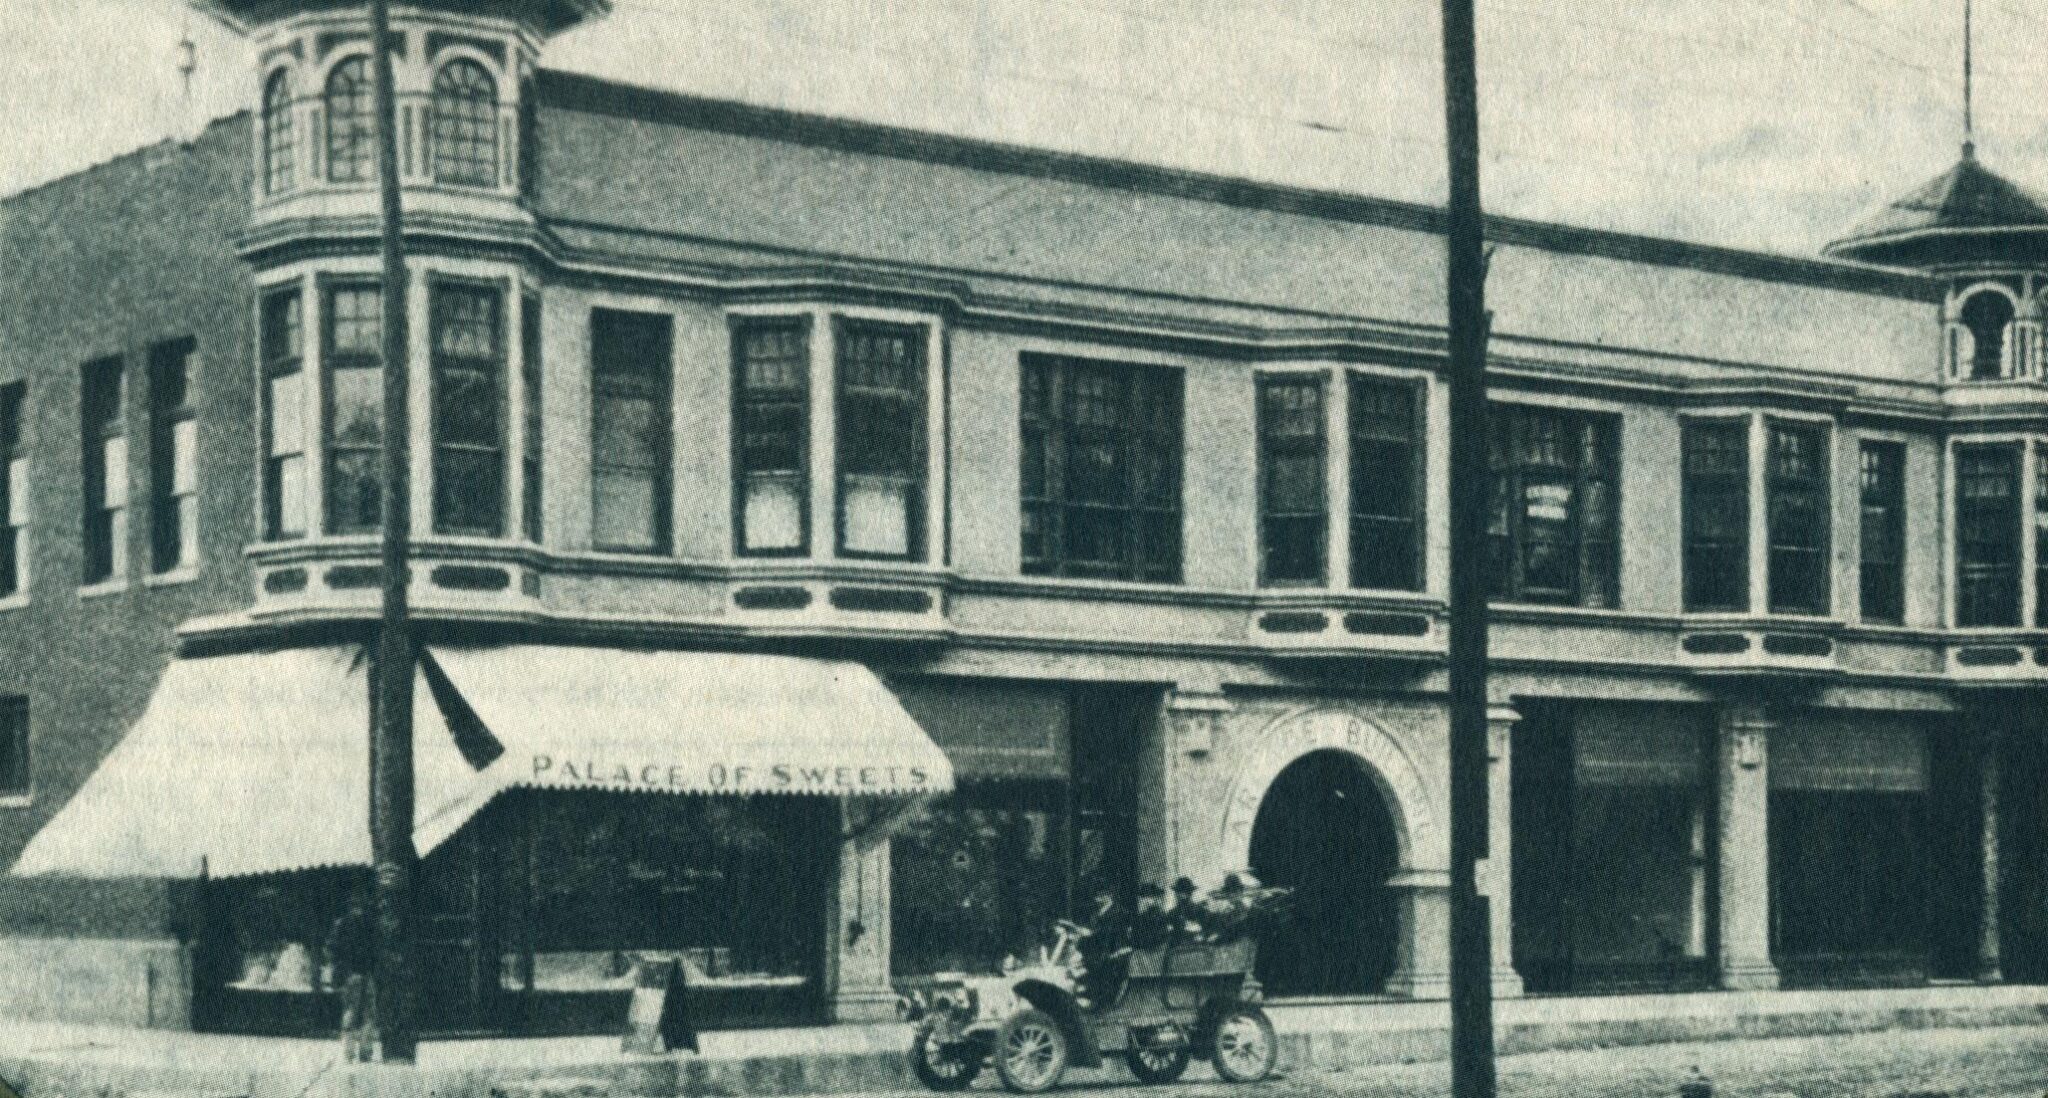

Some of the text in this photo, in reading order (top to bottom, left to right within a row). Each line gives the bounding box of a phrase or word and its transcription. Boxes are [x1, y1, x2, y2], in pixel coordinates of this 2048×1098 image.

[533, 755, 927, 788] PALACE OF SWEETS
